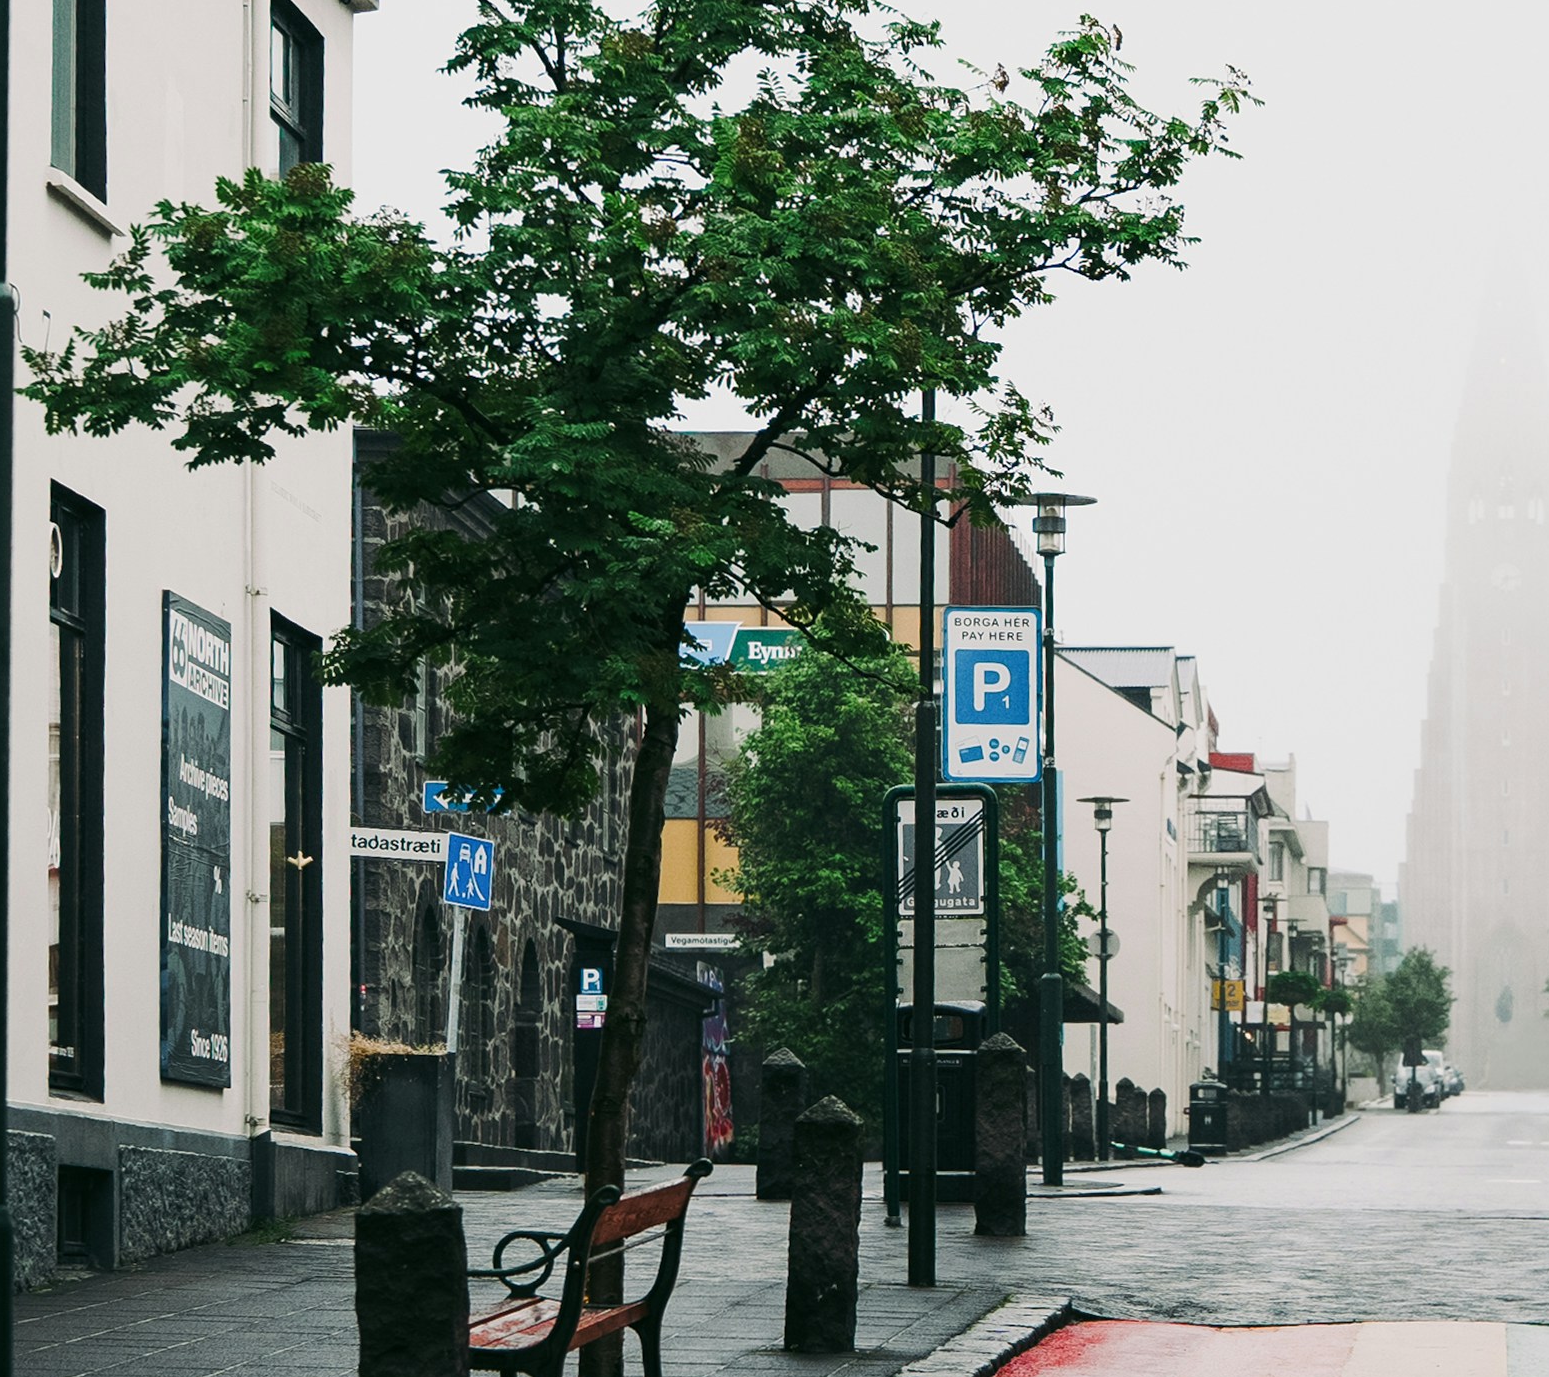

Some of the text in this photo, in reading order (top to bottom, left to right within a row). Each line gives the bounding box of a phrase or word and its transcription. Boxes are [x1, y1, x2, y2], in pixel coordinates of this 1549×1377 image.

[954, 616, 1030, 628] BORGA HÉR
[961, 631, 1024, 641] PAY HERE
[188, 621, 229, 676] NORTH
[189, 666, 227, 706] ARCHIVE
[179, 753, 229, 802] Archive pieces
[168, 796, 198, 838] Samples
[351, 834, 441, 854] taðastræti
[213, 866, 222, 894] %
[168, 913, 229, 957] Last season items
[191, 1028, 228, 1063] Since 1926
